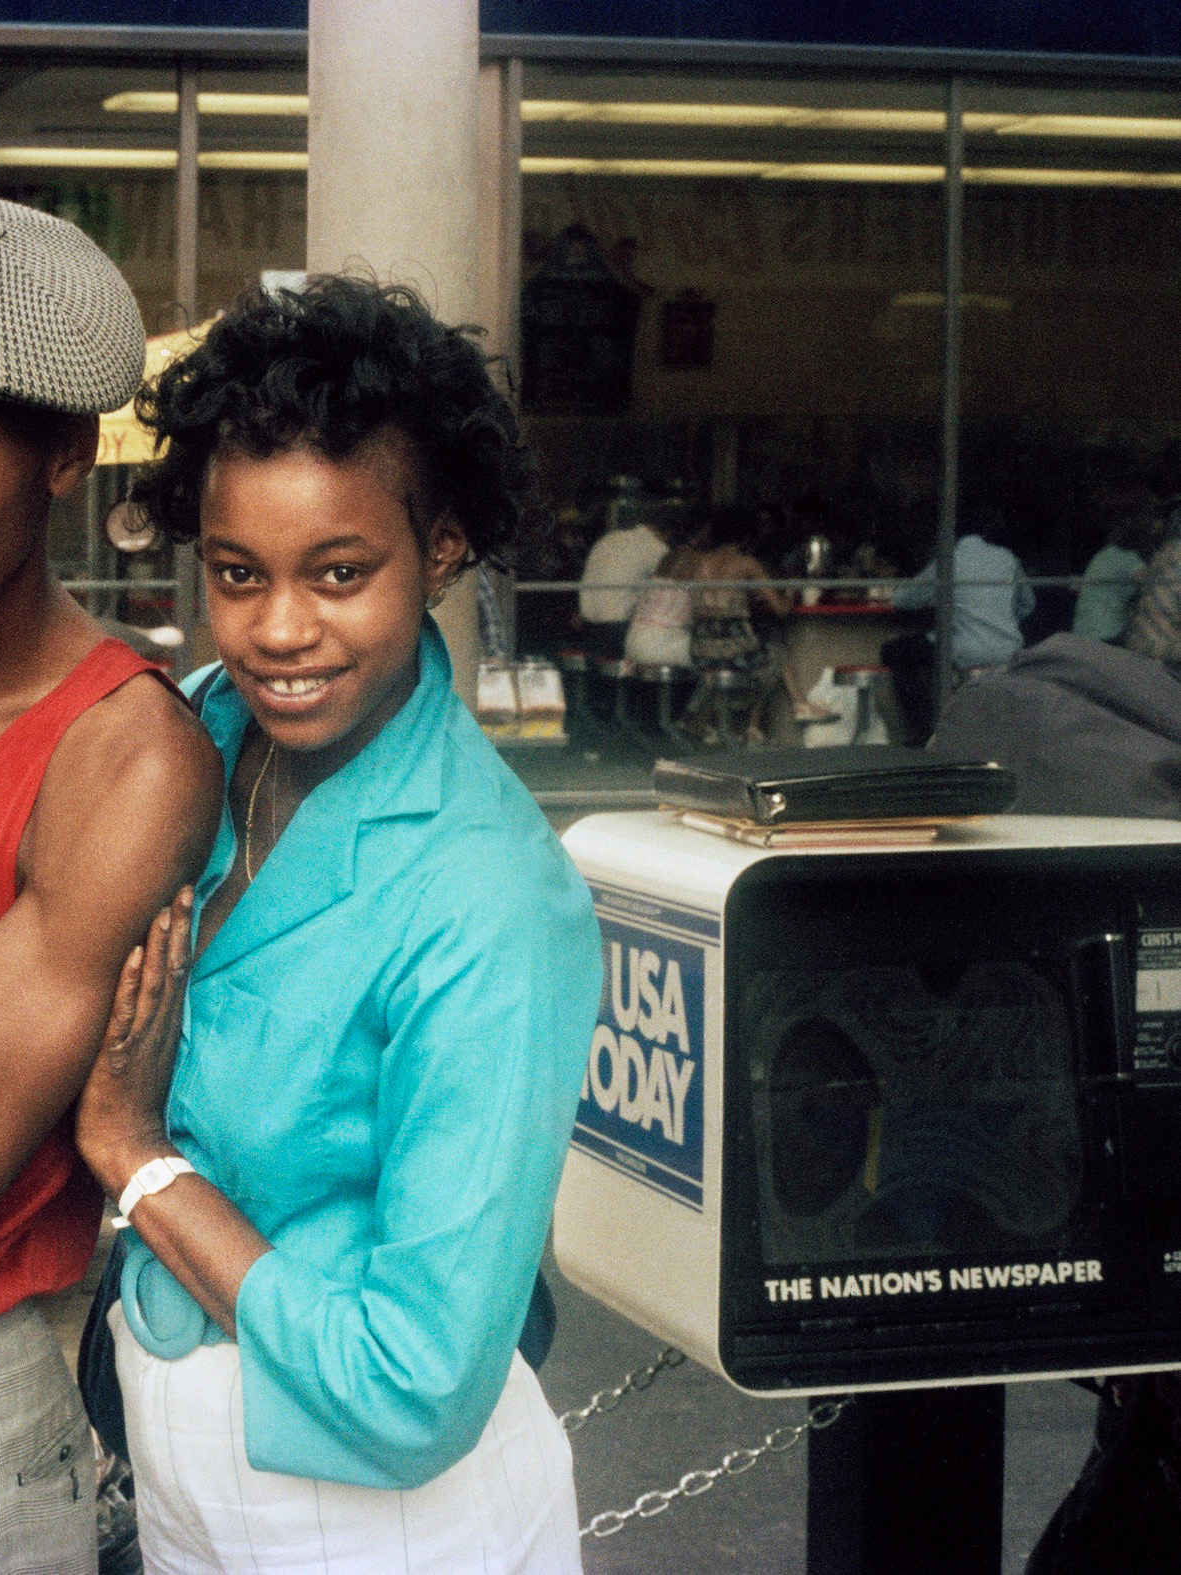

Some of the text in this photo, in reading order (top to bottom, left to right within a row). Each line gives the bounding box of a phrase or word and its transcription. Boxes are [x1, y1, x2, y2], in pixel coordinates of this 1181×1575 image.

[611, 942, 690, 1054] USA
[580, 1024, 695, 1146] ODAY
[765, 1260, 1103, 1301] THE NATION'S NEWSPAPER
